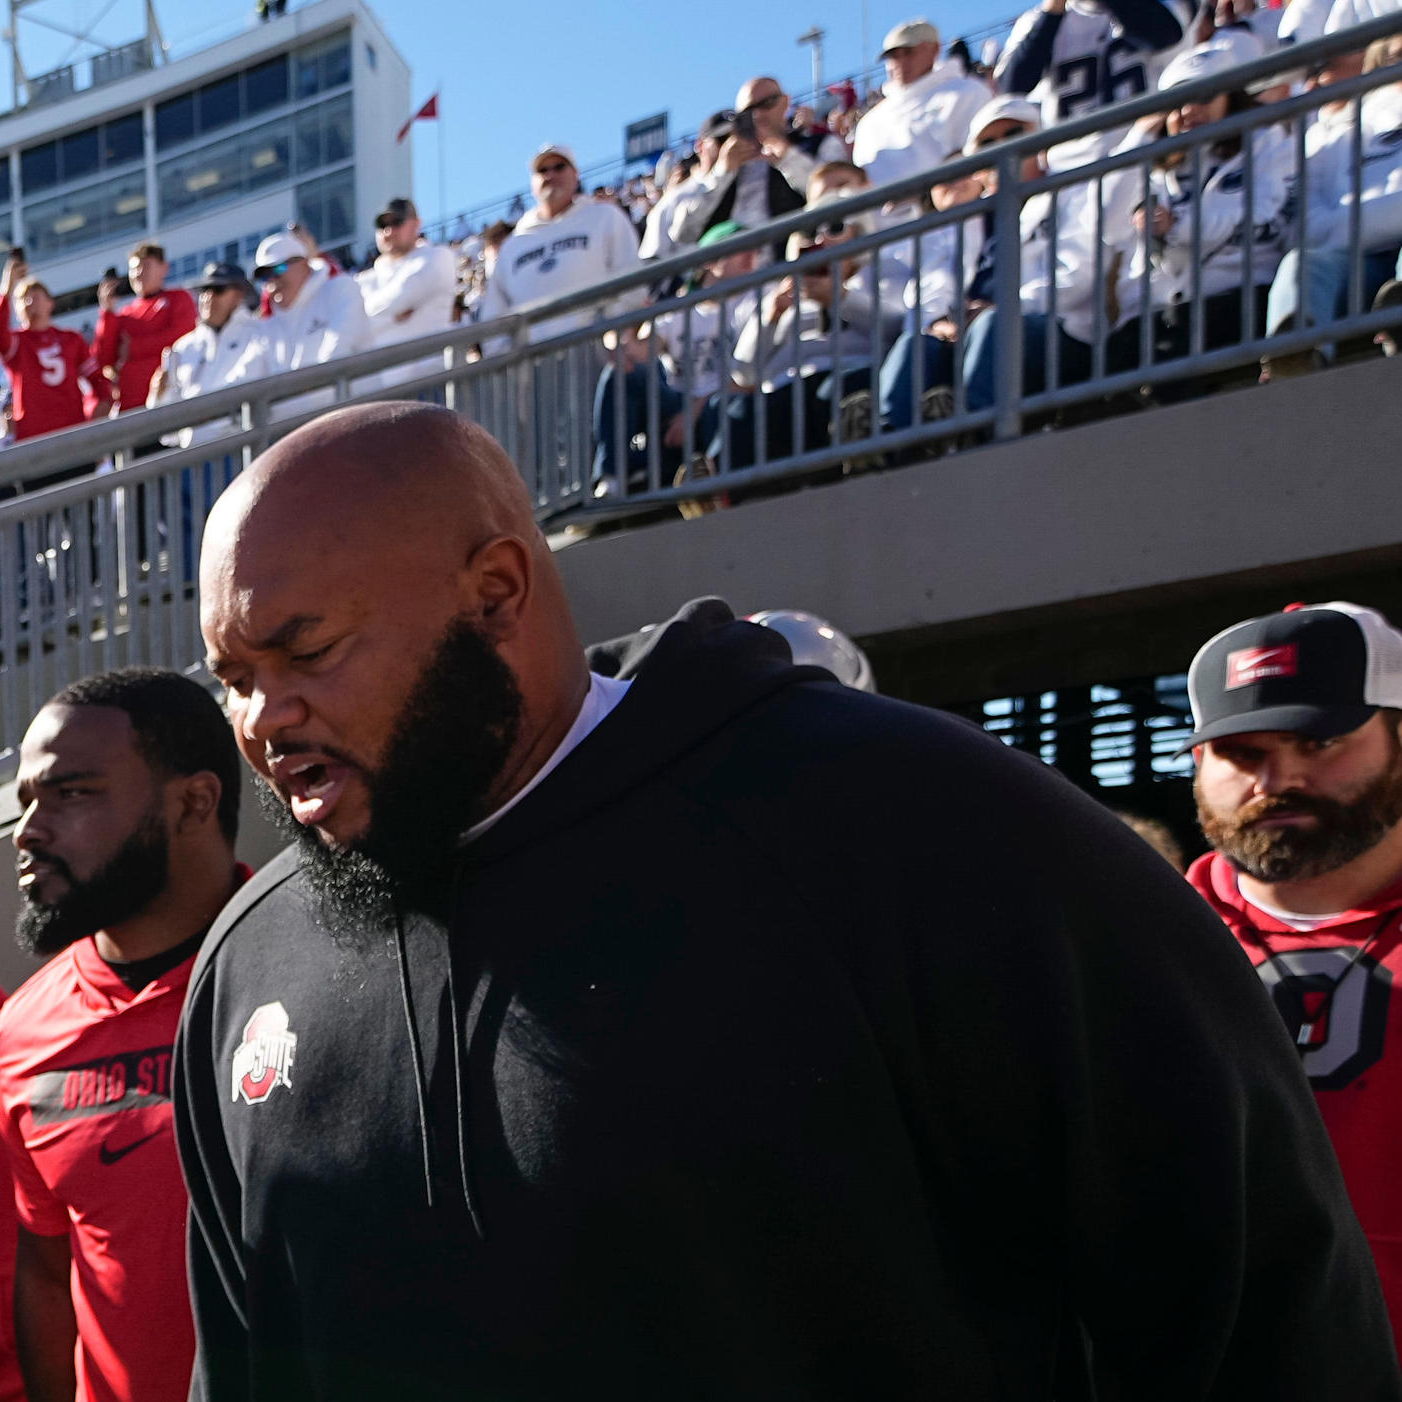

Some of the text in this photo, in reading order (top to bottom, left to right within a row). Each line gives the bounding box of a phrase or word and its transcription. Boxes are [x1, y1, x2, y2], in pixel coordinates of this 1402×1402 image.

[38, 345, 66, 387] 5
[63, 1053, 173, 1110] OHIO ST
